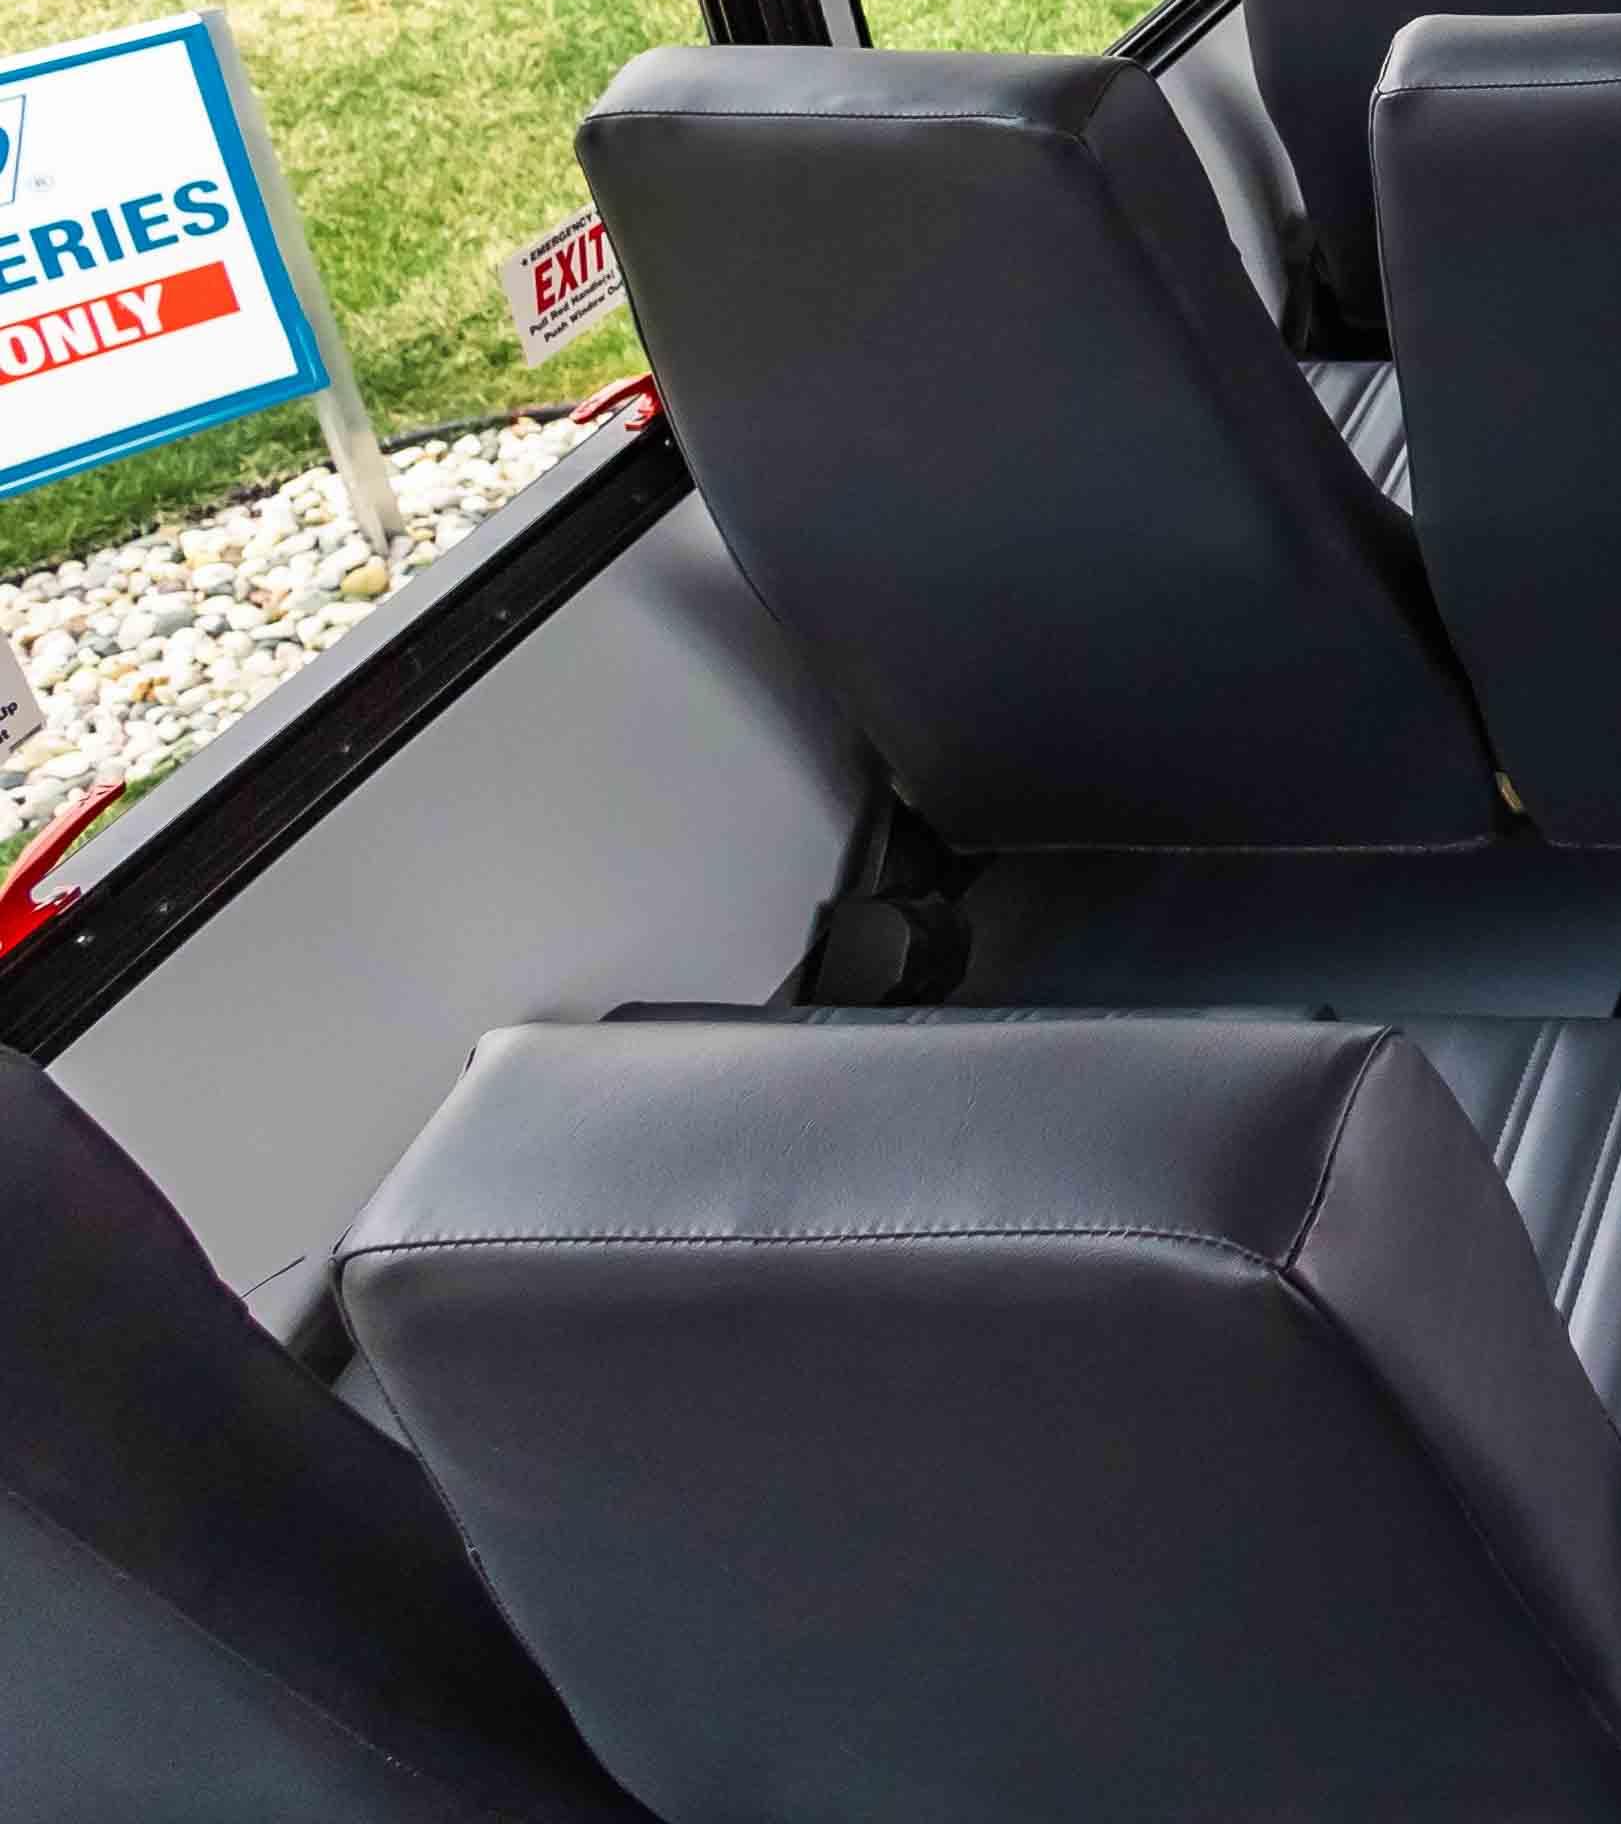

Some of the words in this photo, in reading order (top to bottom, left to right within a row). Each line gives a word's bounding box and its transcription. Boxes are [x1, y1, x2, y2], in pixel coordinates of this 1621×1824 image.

[530, 213, 592, 262] EMERGENCY
[535, 223, 606, 315] EXIT
[0, 283, 163, 376] ONLY
